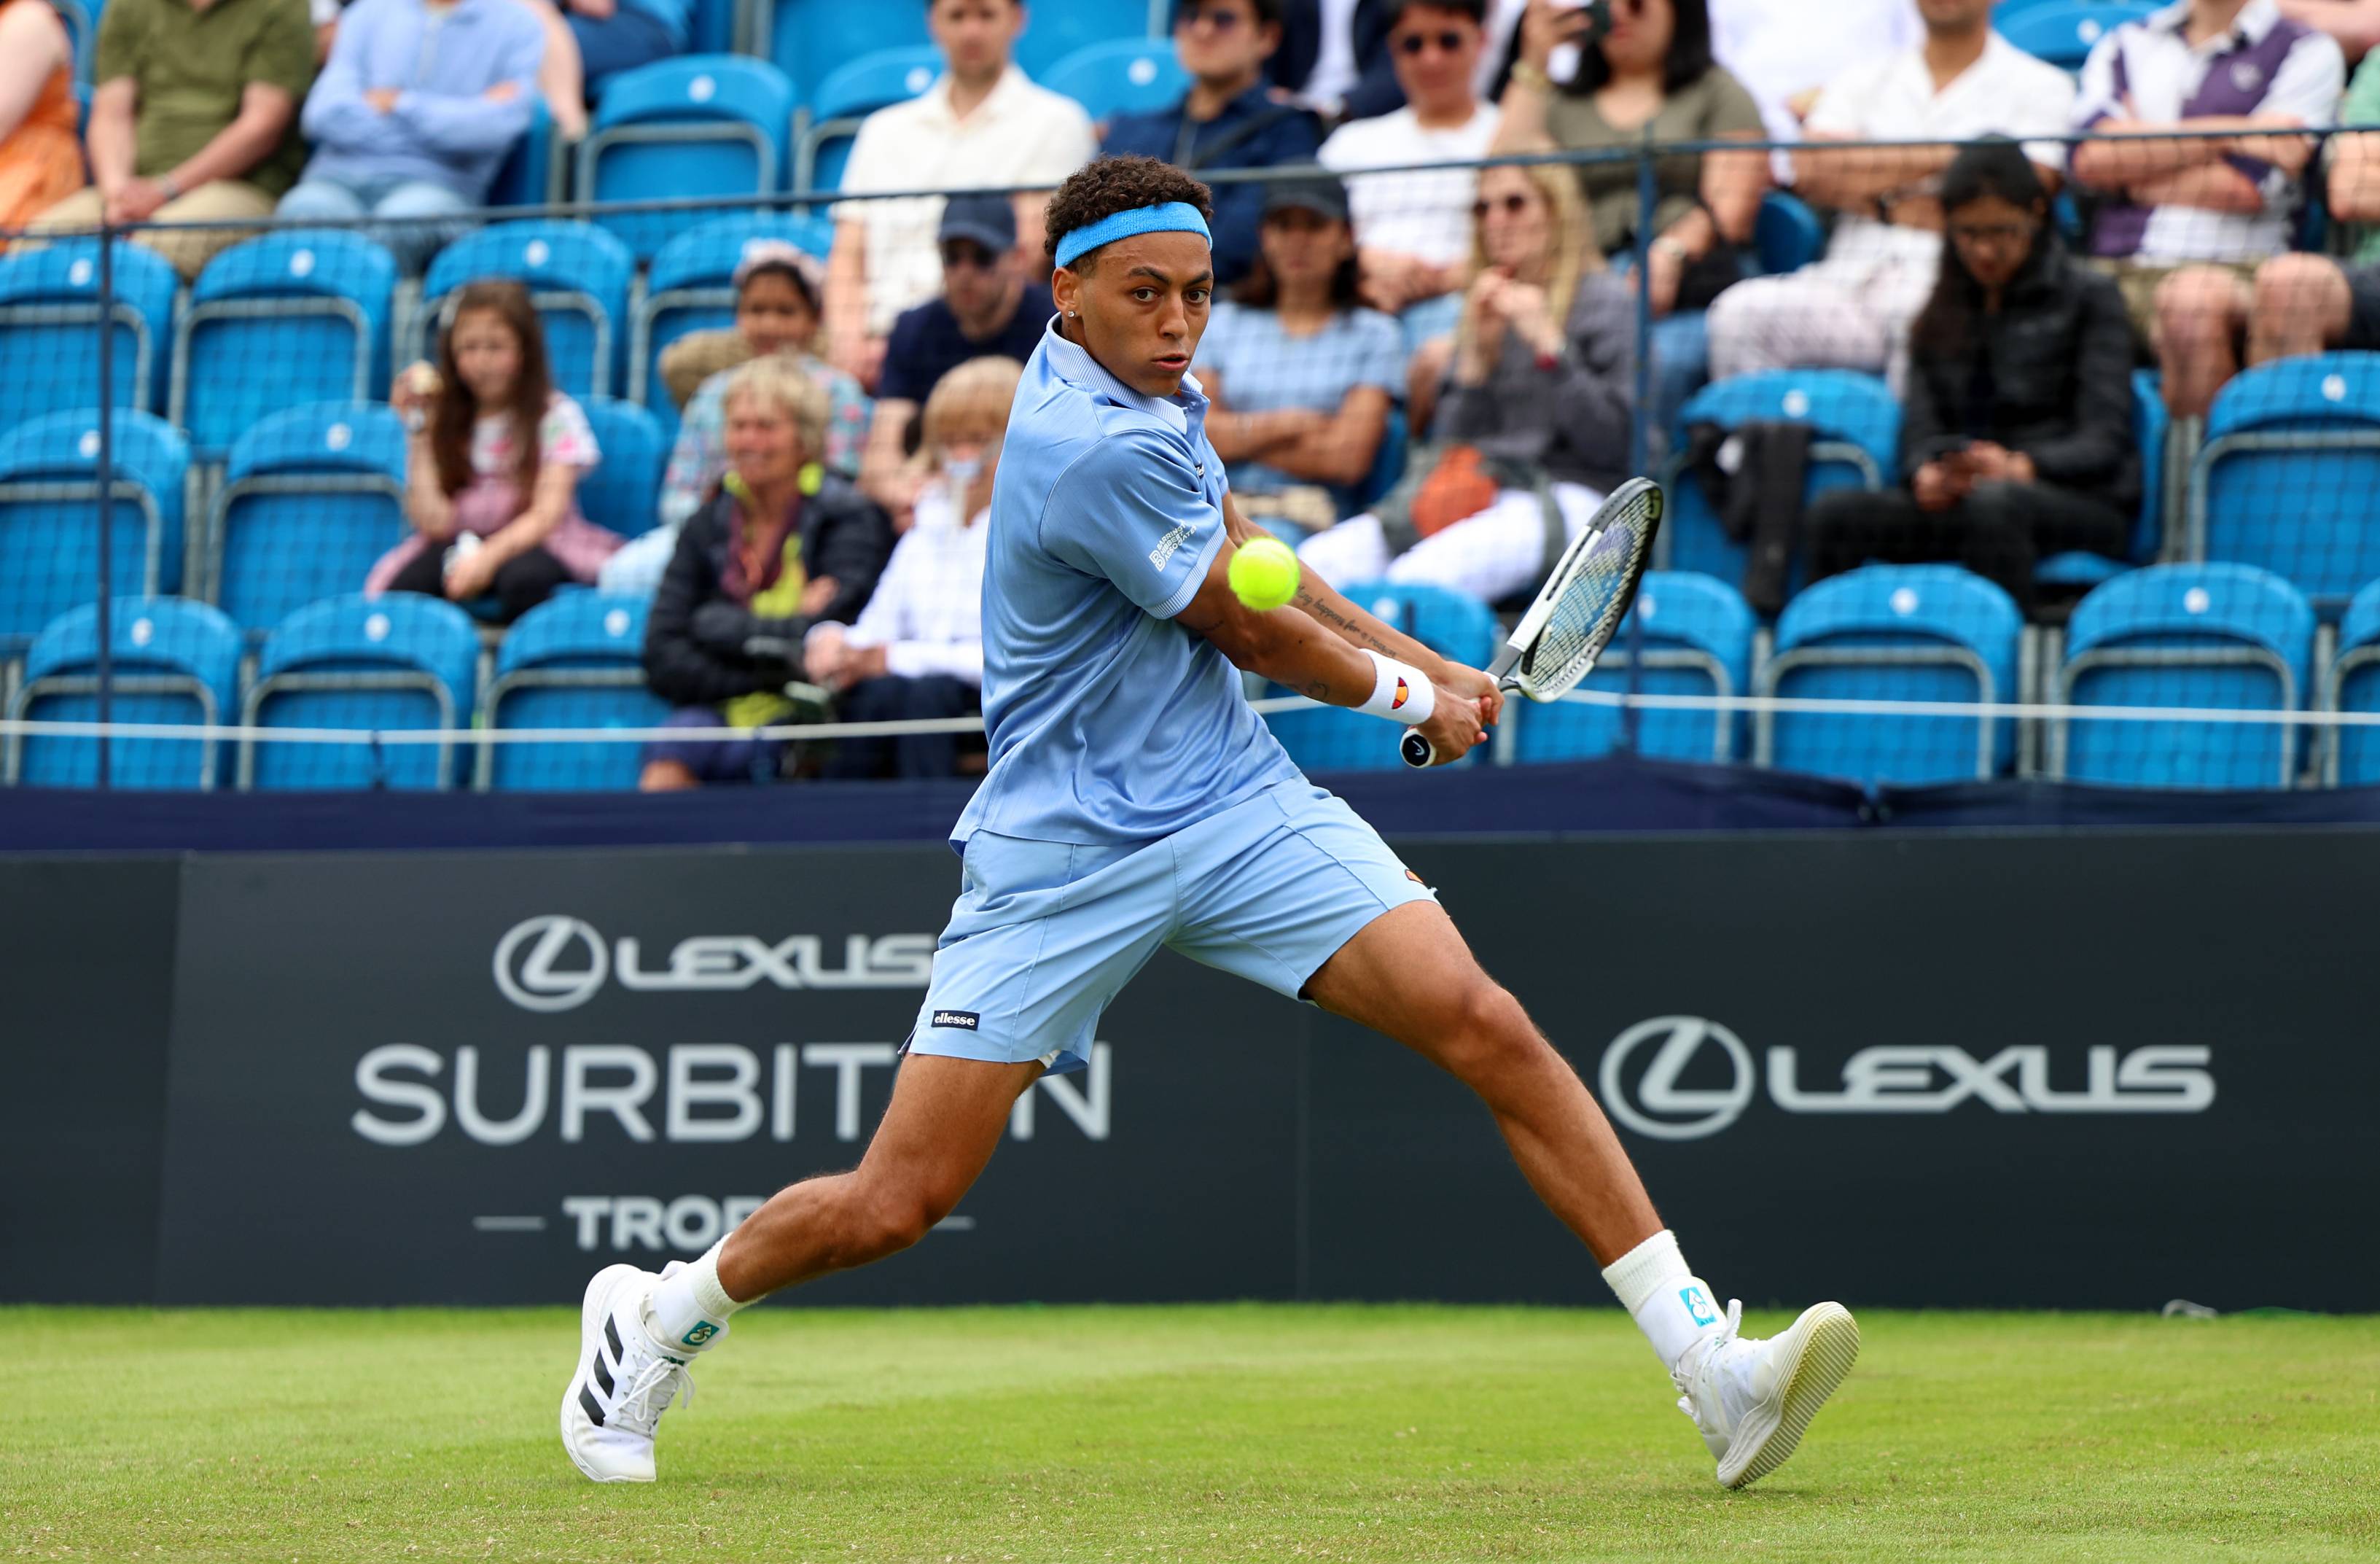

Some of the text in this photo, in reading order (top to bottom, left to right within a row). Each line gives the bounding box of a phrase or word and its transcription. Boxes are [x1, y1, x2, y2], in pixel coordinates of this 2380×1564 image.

[1157, 519, 1187, 549] BARRINGT
[615, 933, 934, 989] LEXUS
[935, 1013, 975, 1026] ellesse
[351, 1043, 1112, 1145] SURBITN
[1767, 1046, 2216, 1113] LEXUS
